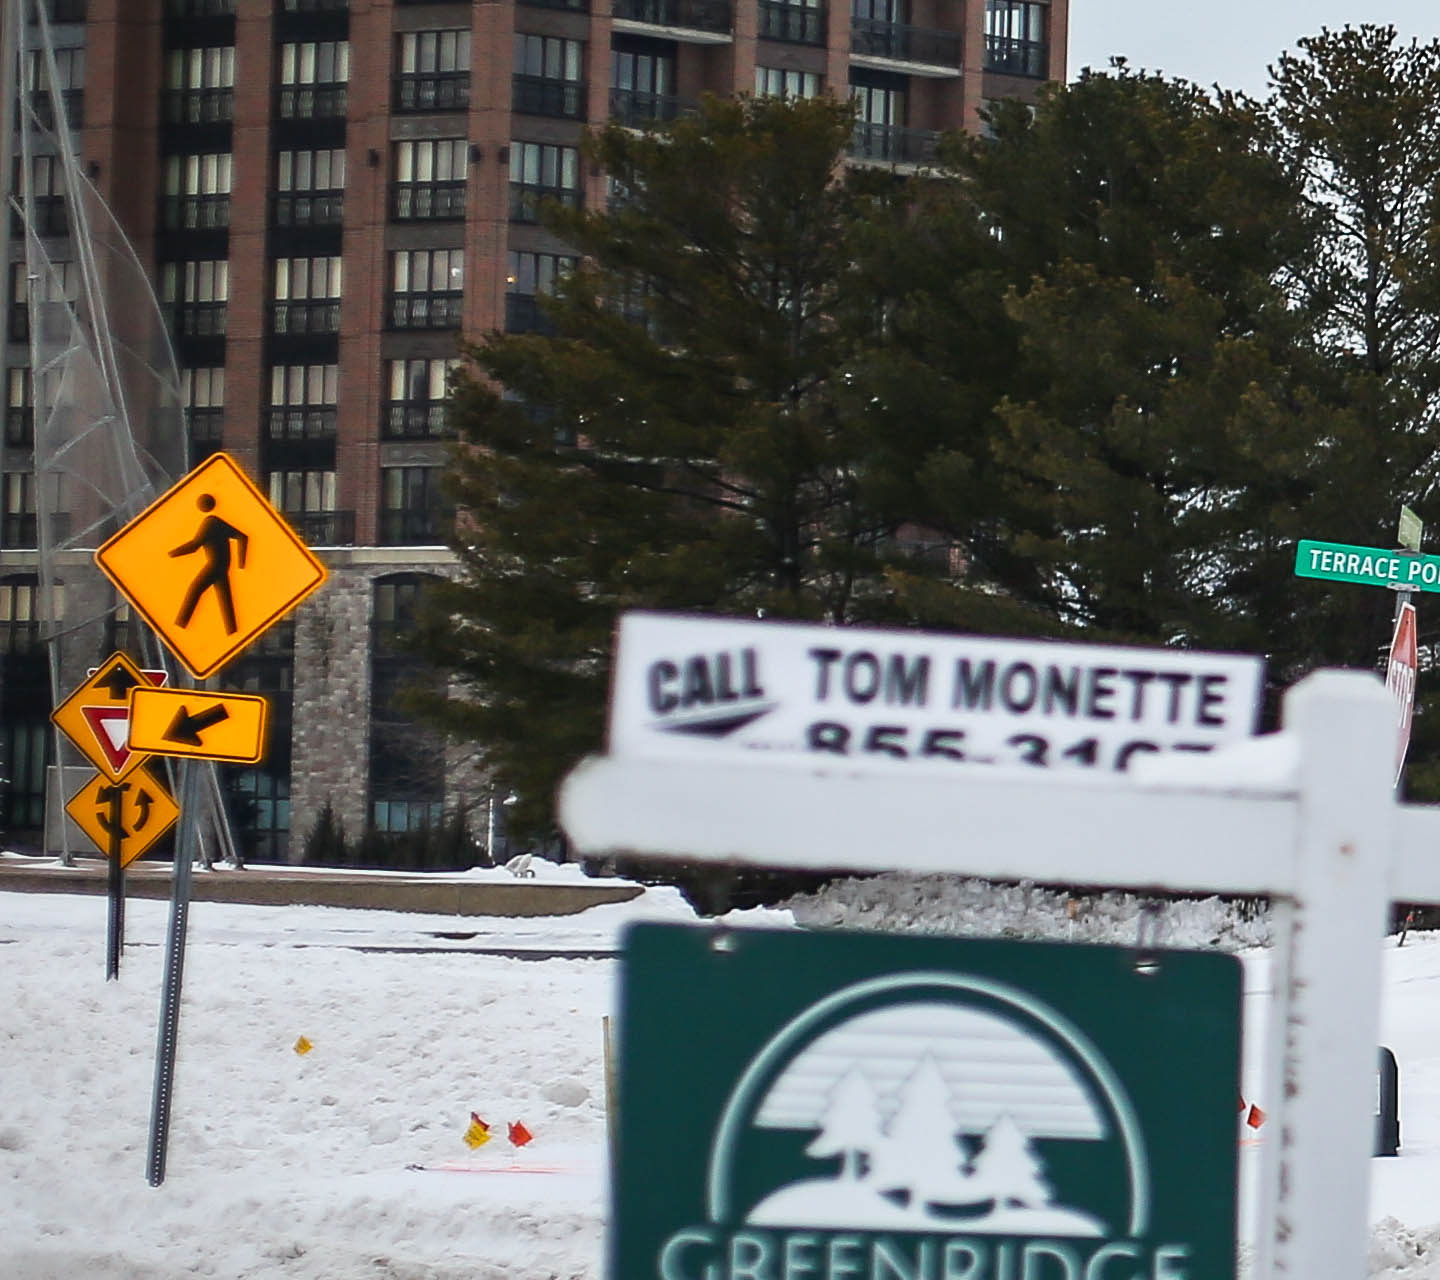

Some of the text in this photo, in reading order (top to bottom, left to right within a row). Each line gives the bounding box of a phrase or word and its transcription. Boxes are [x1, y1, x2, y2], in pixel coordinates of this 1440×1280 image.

[1309, 548, 1400, 580] TERRACE
[646, 646, 1229, 727] CALL TOM MONETTE
